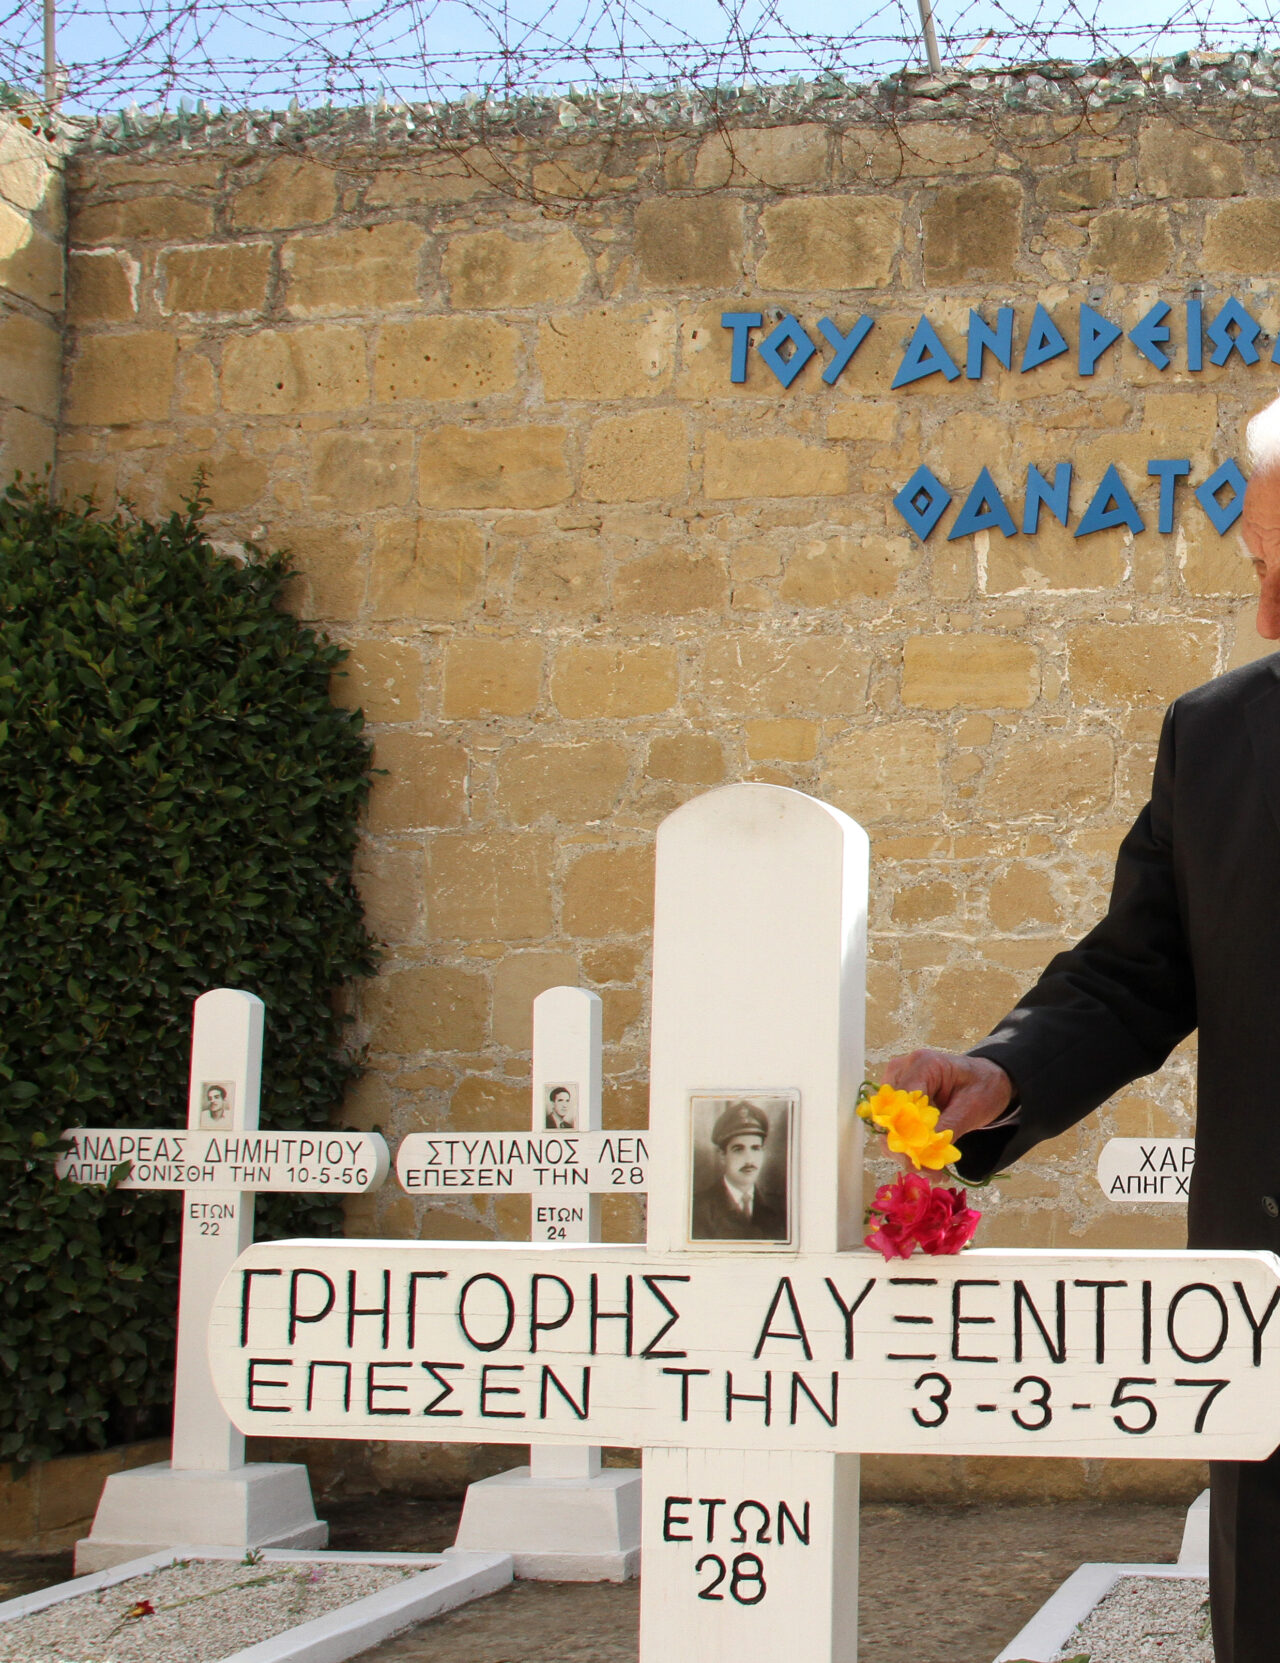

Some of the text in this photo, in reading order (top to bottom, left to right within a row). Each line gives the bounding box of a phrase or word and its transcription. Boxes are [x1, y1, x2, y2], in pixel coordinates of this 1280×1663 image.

[721, 312, 874, 389] ΤΟΥ
[893, 457, 1247, 542] ΘΑΝΑΤΟ
[65, 1136, 364, 1164] ΑΝΔΡΕΑΣ ΔΗΜΗΤΡΙΟΥ
[427, 1138, 649, 1165] ΣΤΥΛΙΑΝΟΣ ΛΕΝ
[1140, 1146, 1196, 1173] ΧΑΡ
[230, 1166, 271, 1182] ΤΗΝ
[286, 1168, 368, 1185] 10-5-56
[406, 1167, 644, 1187] ΕΠΕΣΕΝ ΤΗΝ 28
[1110, 1175, 1189, 1195] ΑΠΗΓΧ
[190, 1203, 235, 1219] ΕΤΩΝ
[537, 1207, 583, 1222] ΕΤΩΝ
[199, 1222, 220, 1236] 22
[547, 1226, 567, 1240] 24
[241, 1269, 690, 1360] ΓΡΗΓΟΡΗΣ
[248, 1359, 1231, 1434] ΕΠΕΣΕΝ ΤΗΝ 3-3-57
[663, 1496, 810, 1545] ΕΤΩΝ
[695, 1552, 767, 1605] 28
